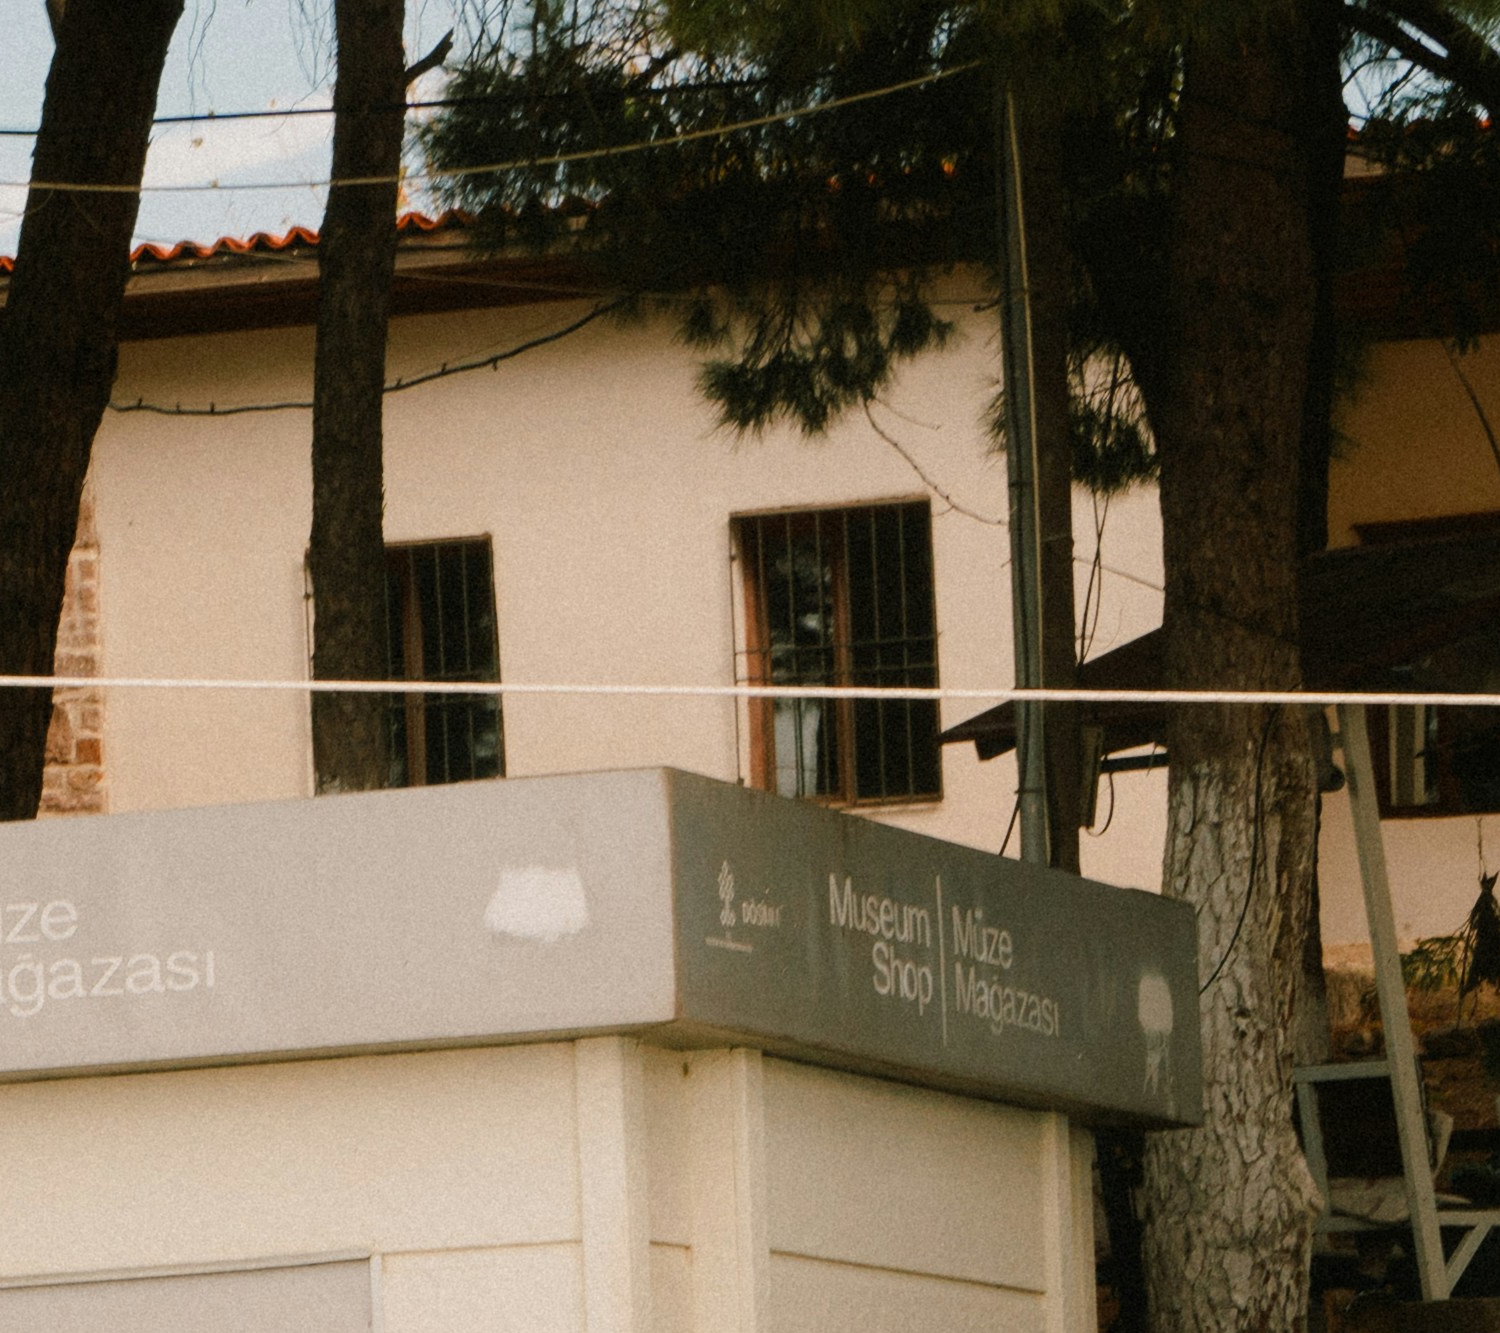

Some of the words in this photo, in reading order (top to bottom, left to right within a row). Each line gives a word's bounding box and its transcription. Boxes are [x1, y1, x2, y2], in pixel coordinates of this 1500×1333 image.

[828, 872, 930, 948] Museum
[952, 905, 1014, 970] Müze
[872, 941, 933, 1016] Shop
[954, 963, 1061, 1037] Mağazası
